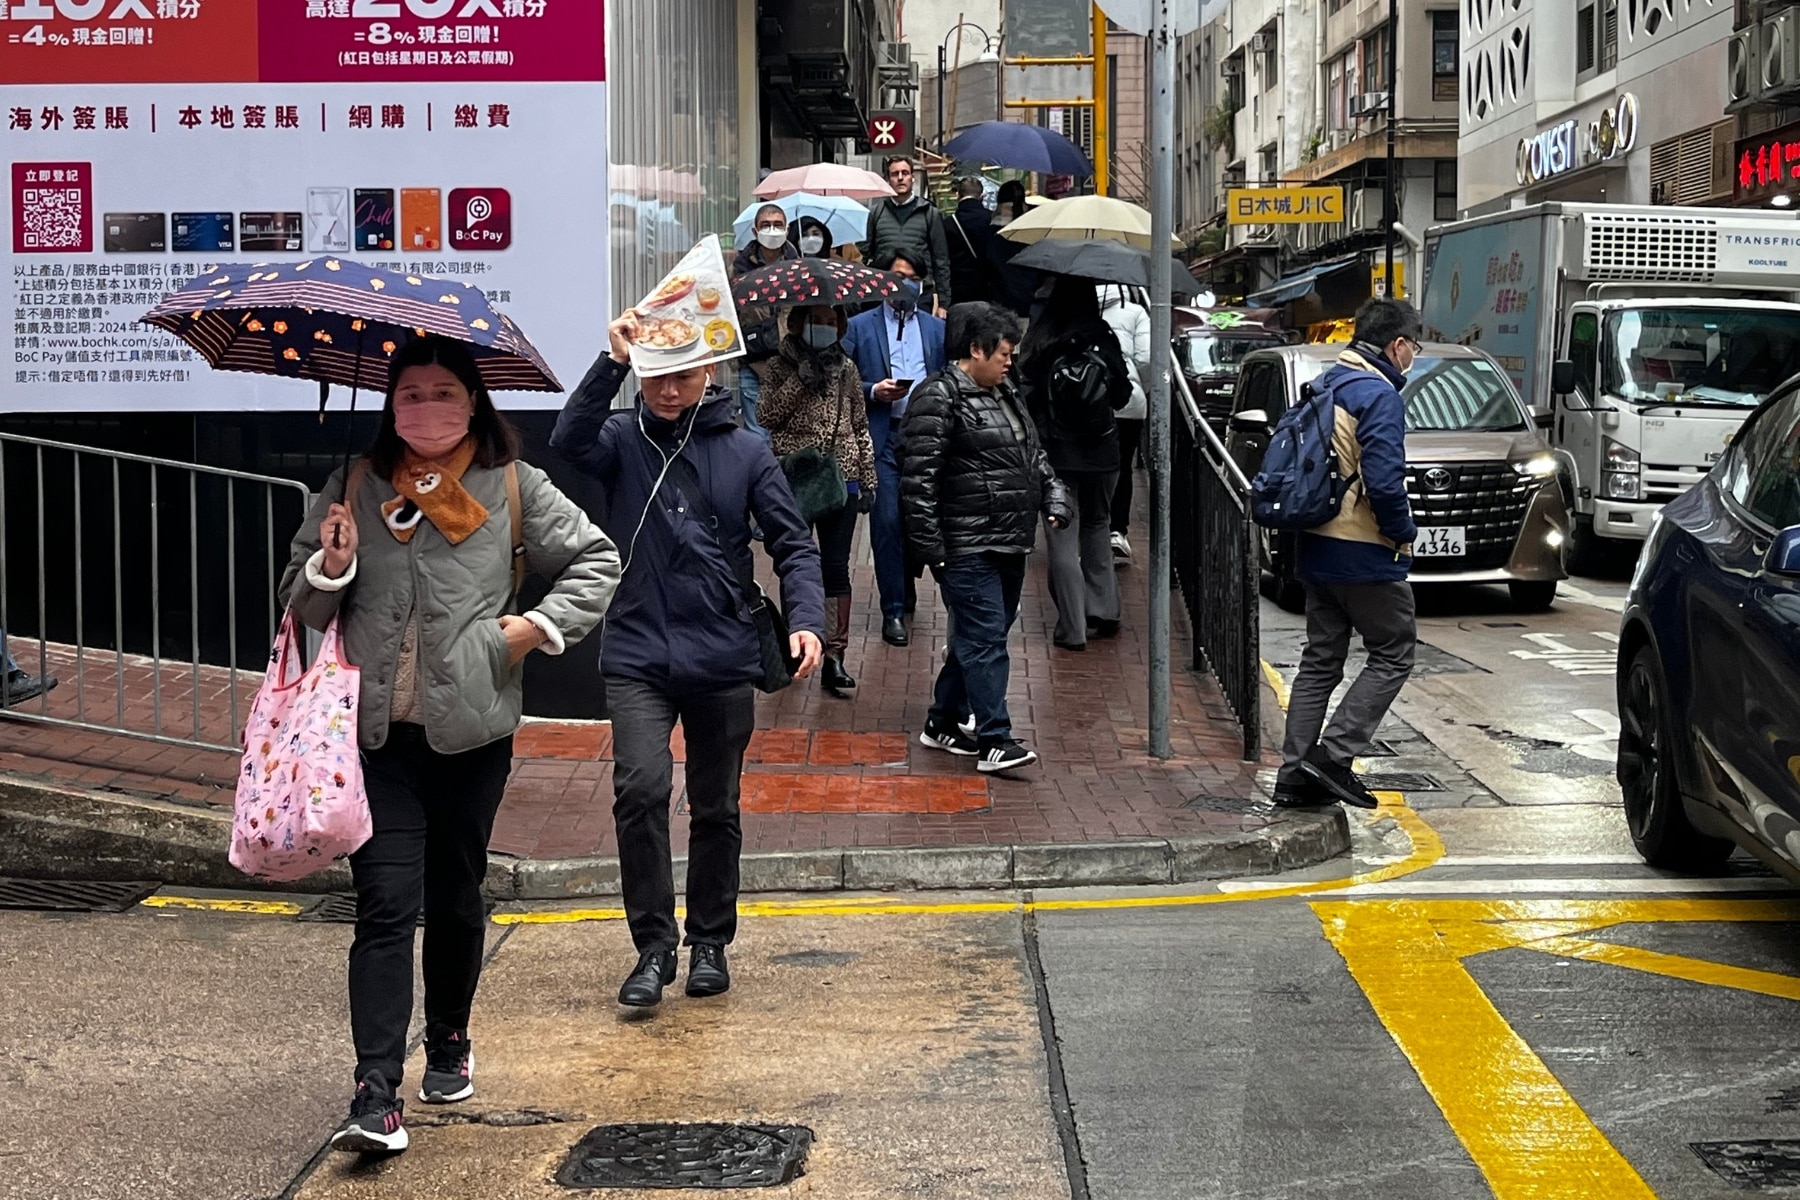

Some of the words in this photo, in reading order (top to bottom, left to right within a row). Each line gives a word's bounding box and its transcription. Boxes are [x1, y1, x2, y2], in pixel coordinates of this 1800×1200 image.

[348, 104, 405, 129] 網購
[454, 104, 510, 128] 繳費
[25, 170, 79, 182] 立即登記
[1239, 196, 1292, 216] 日本城
[1294, 196, 1334, 215] JHC
[456, 230, 479, 241] BoC
[483, 230, 503, 243] Pay
[16, 352, 38, 363] BoC
[1428, 528, 1450, 541] YZ
[1417, 541, 1461, 555] 4346
